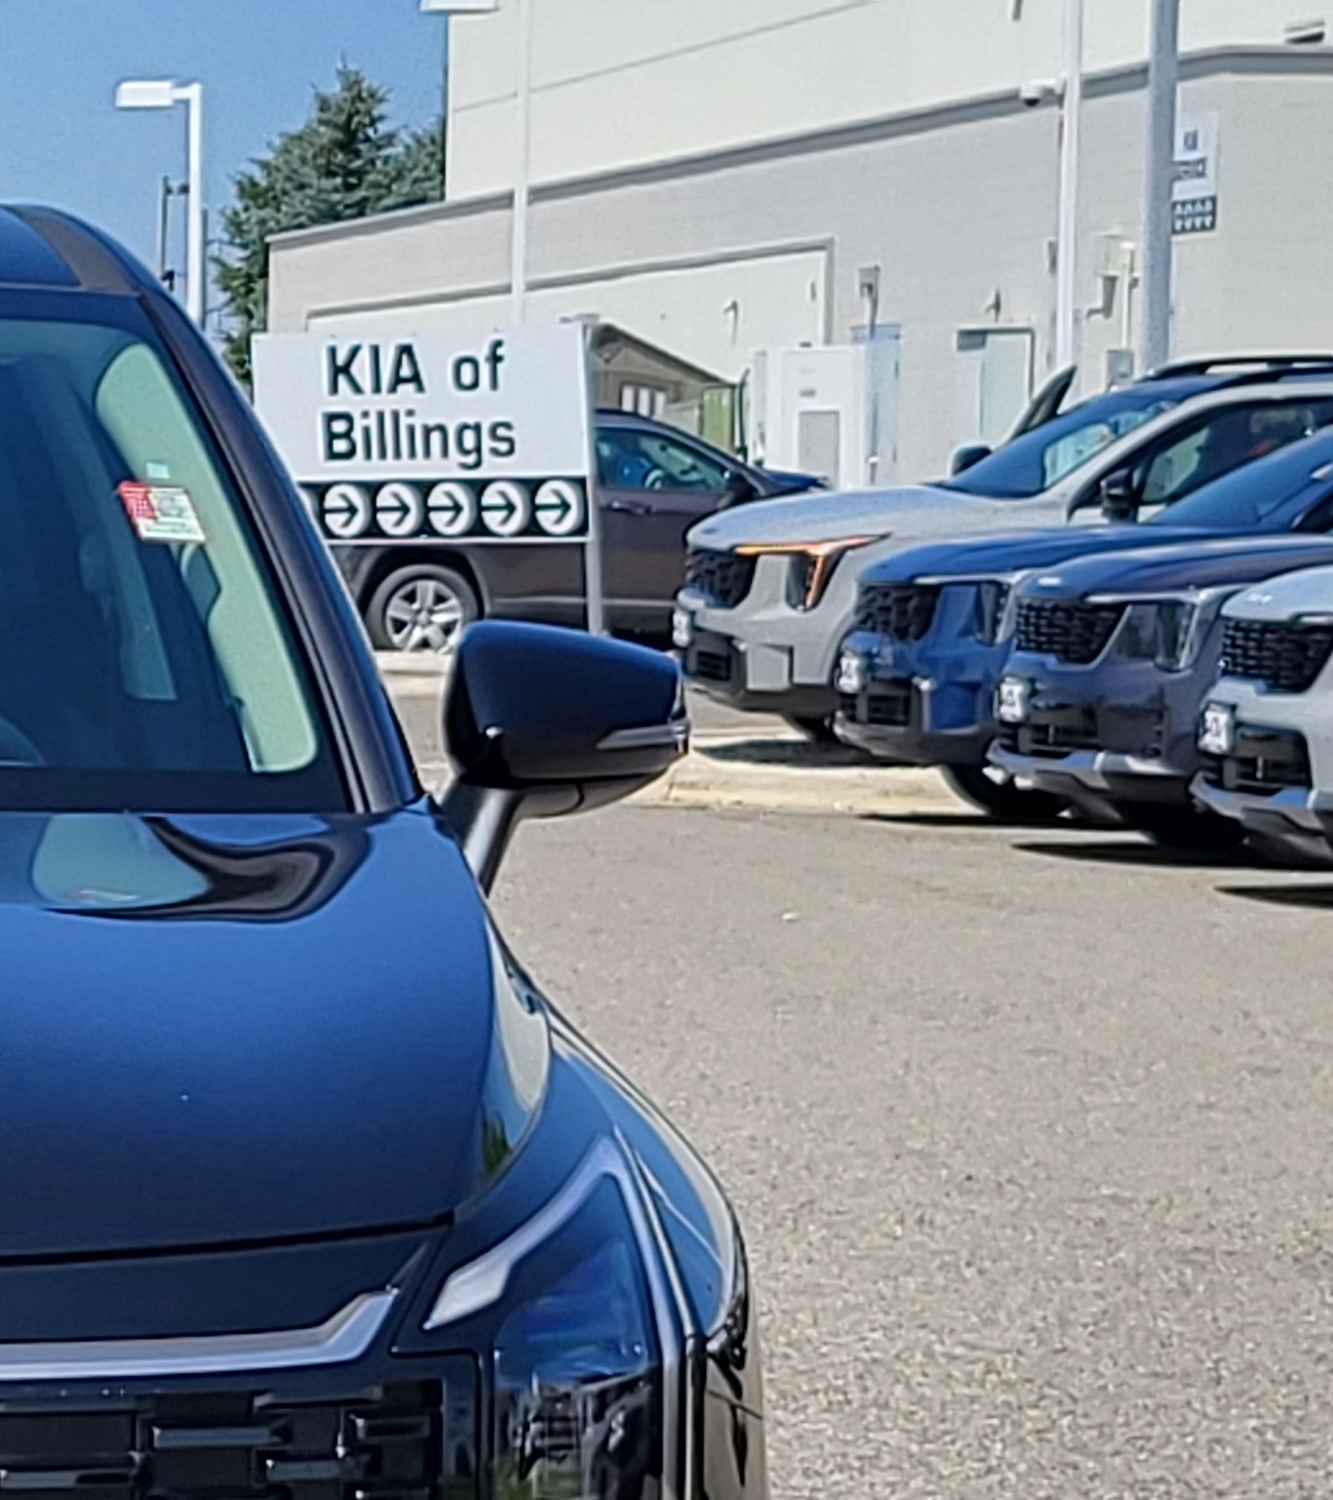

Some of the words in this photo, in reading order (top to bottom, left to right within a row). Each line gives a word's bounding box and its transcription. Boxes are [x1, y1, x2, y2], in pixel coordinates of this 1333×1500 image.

[326, 344, 426, 396] KIA
[452, 339, 505, 391] of
[322, 409, 516, 470] Billings
